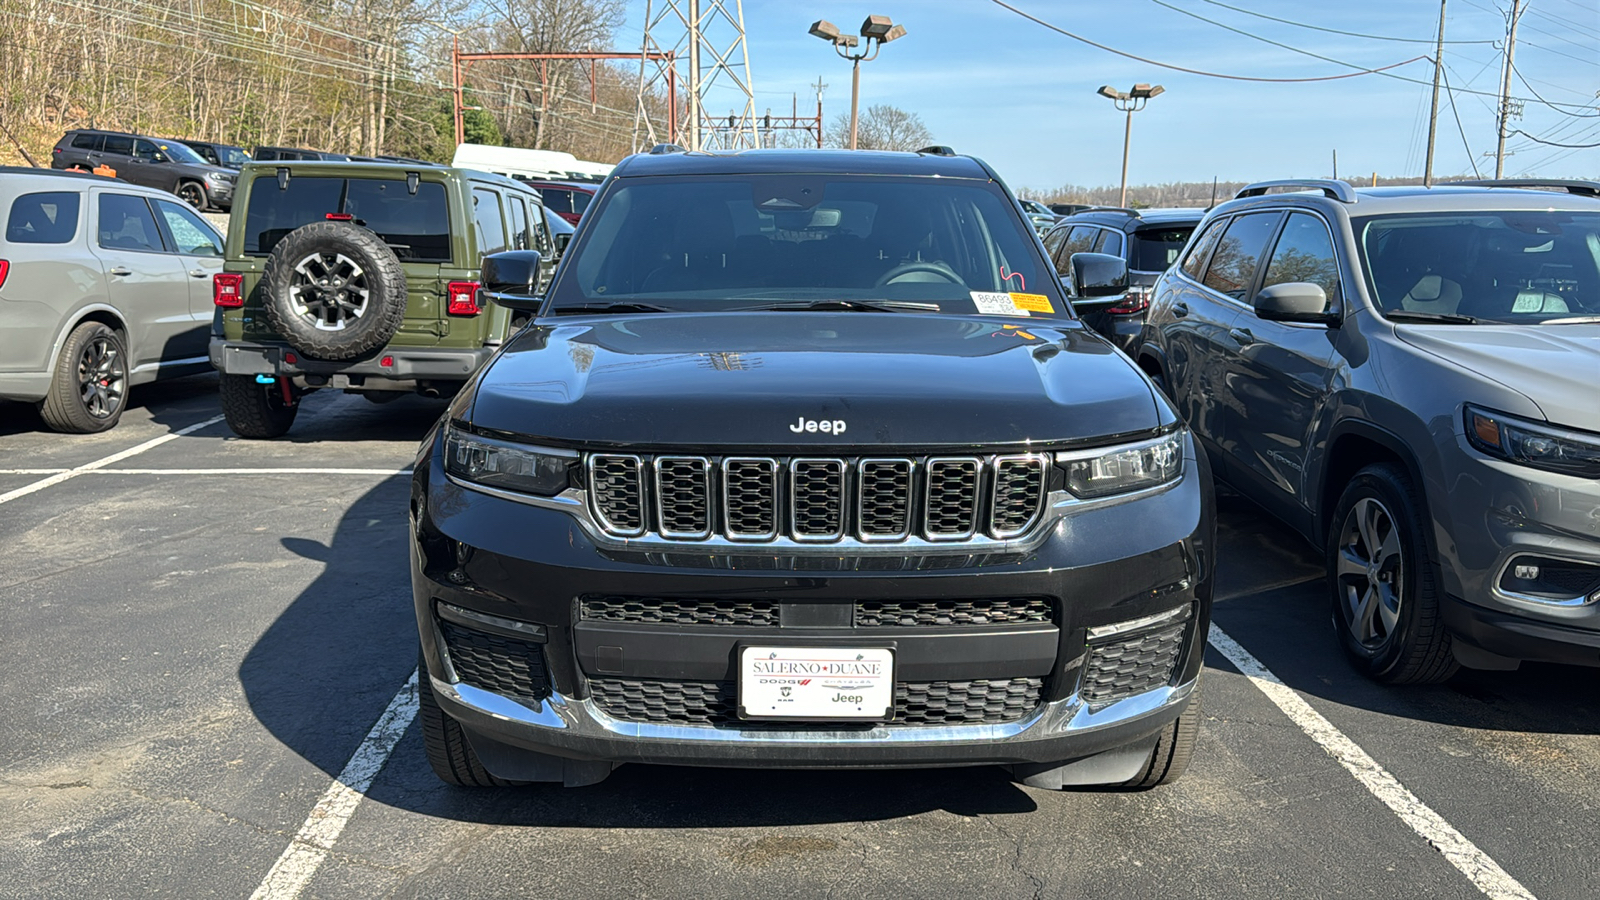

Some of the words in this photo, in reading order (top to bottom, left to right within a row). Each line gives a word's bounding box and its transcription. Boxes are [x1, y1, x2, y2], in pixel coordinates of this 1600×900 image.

[789, 416, 847, 435] Jeep
[753, 662, 821, 674] SALERNO
[829, 663, 881, 675] DUANE
[831, 693, 863, 705] Jeep
